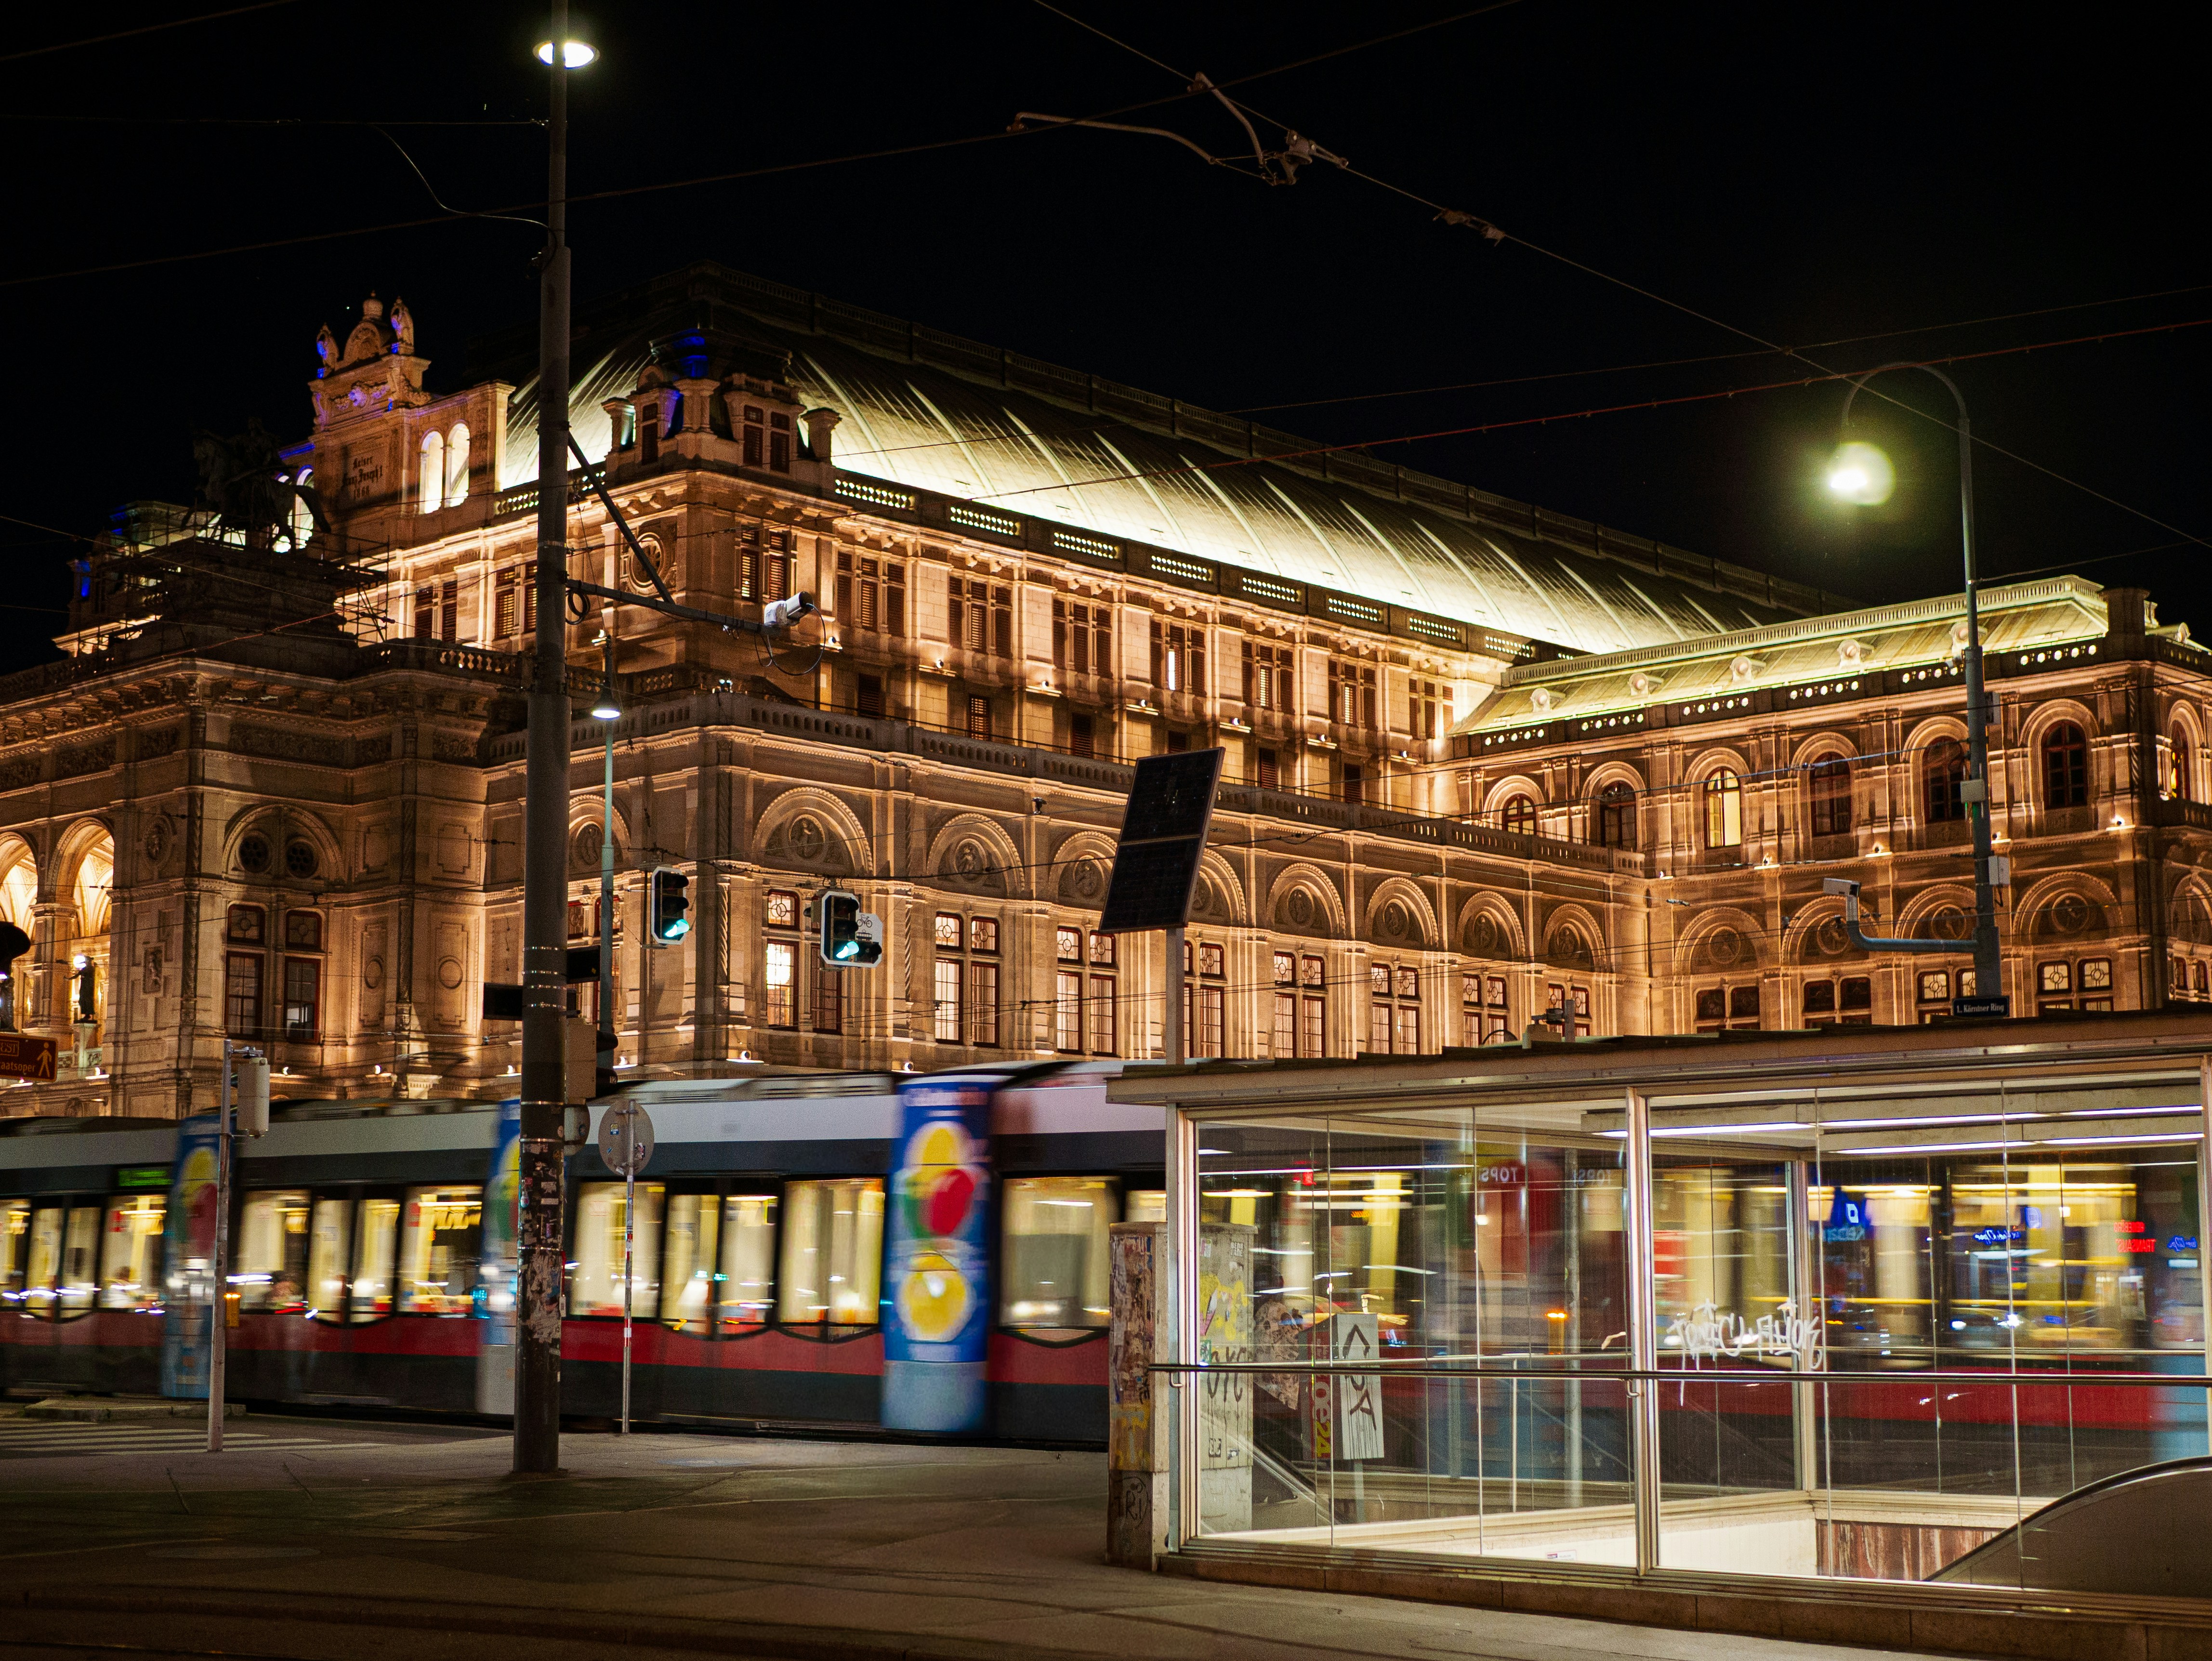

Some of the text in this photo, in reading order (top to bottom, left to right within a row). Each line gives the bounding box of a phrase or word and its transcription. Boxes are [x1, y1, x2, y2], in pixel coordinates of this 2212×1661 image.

[1963, 1004, 1989, 1013] Kärntner
[1990, 1002, 2004, 1013] Ring
[0, 1061, 36, 1076] aatsoper
